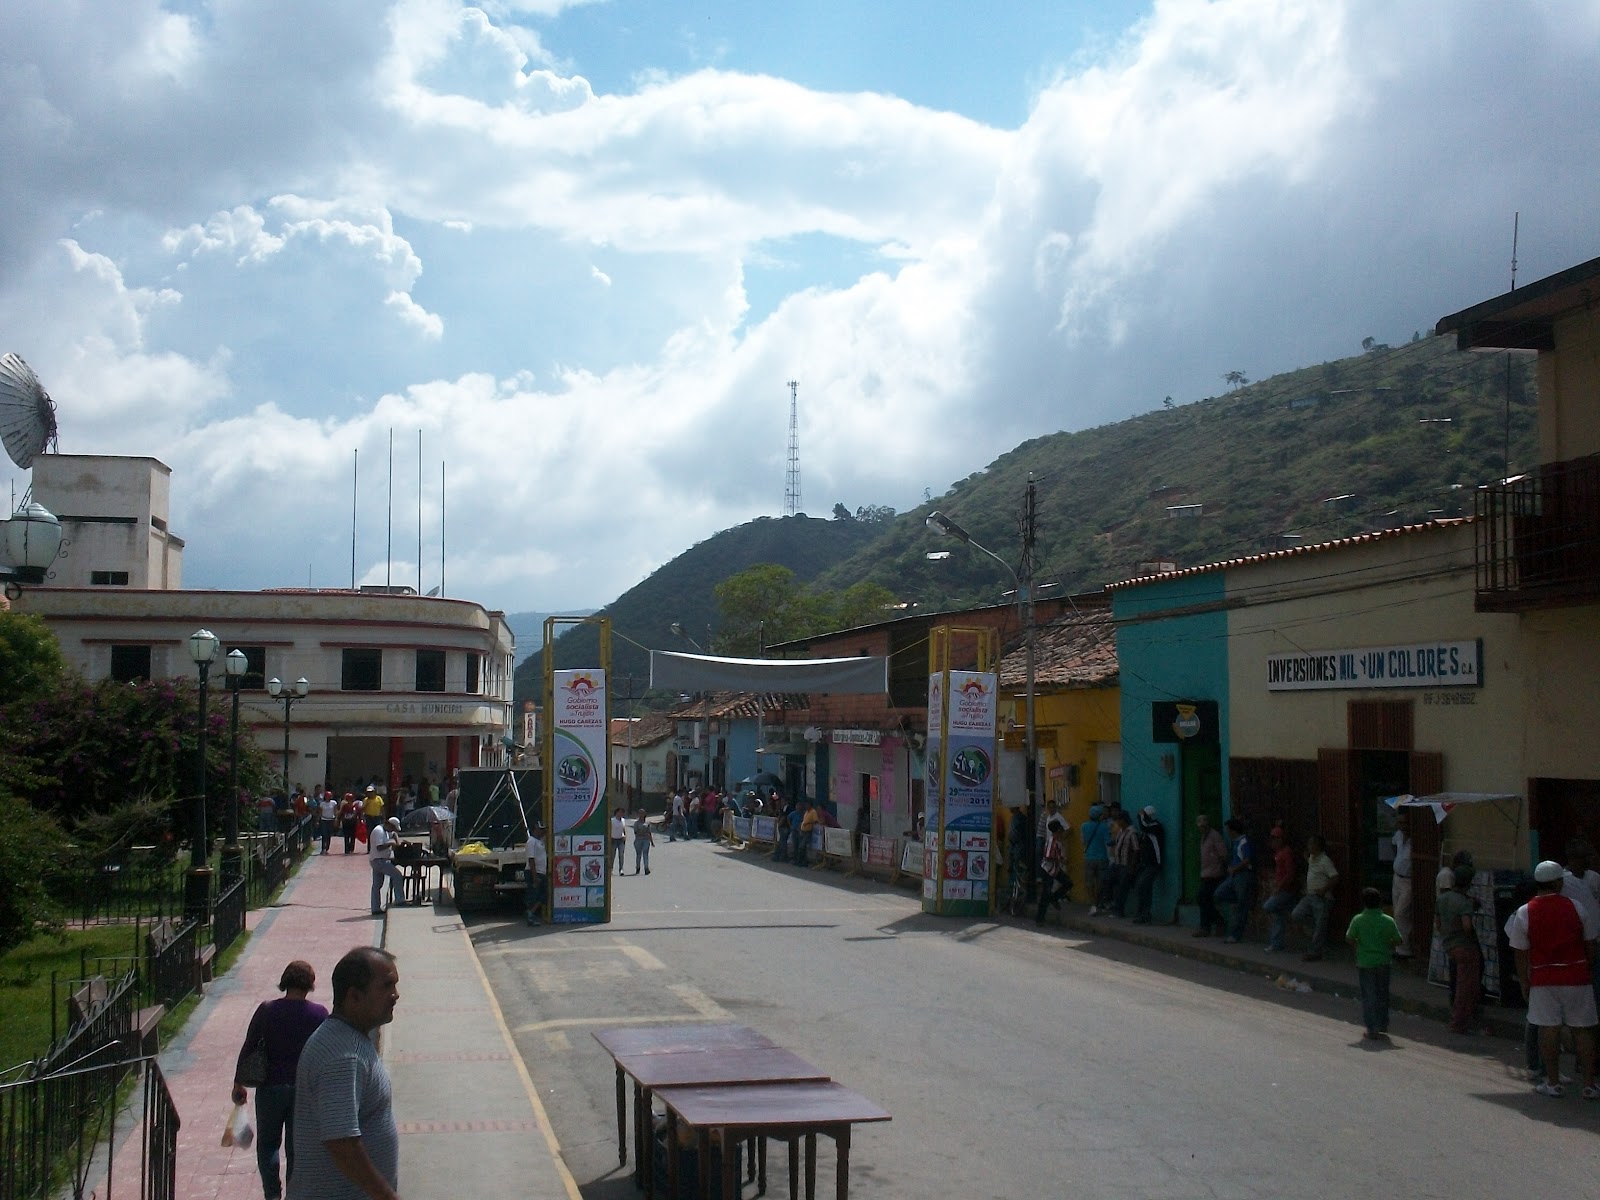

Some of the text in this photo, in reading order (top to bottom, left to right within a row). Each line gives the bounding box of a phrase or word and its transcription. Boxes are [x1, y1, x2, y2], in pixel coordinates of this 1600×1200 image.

[1267, 655, 1336, 683] INVERSIONES
[1360, 655, 1368, 675] Y
[1368, 651, 1385, 679] UN
[1388, 646, 1459, 679] COLORES
[567, 696, 597, 704] Gobierno
[959, 699, 987, 707] Gobierno
[386, 703, 463, 713] CASA MUNICIPAL
[949, 787, 958, 796] 29
[969, 797, 990, 805] 2011
